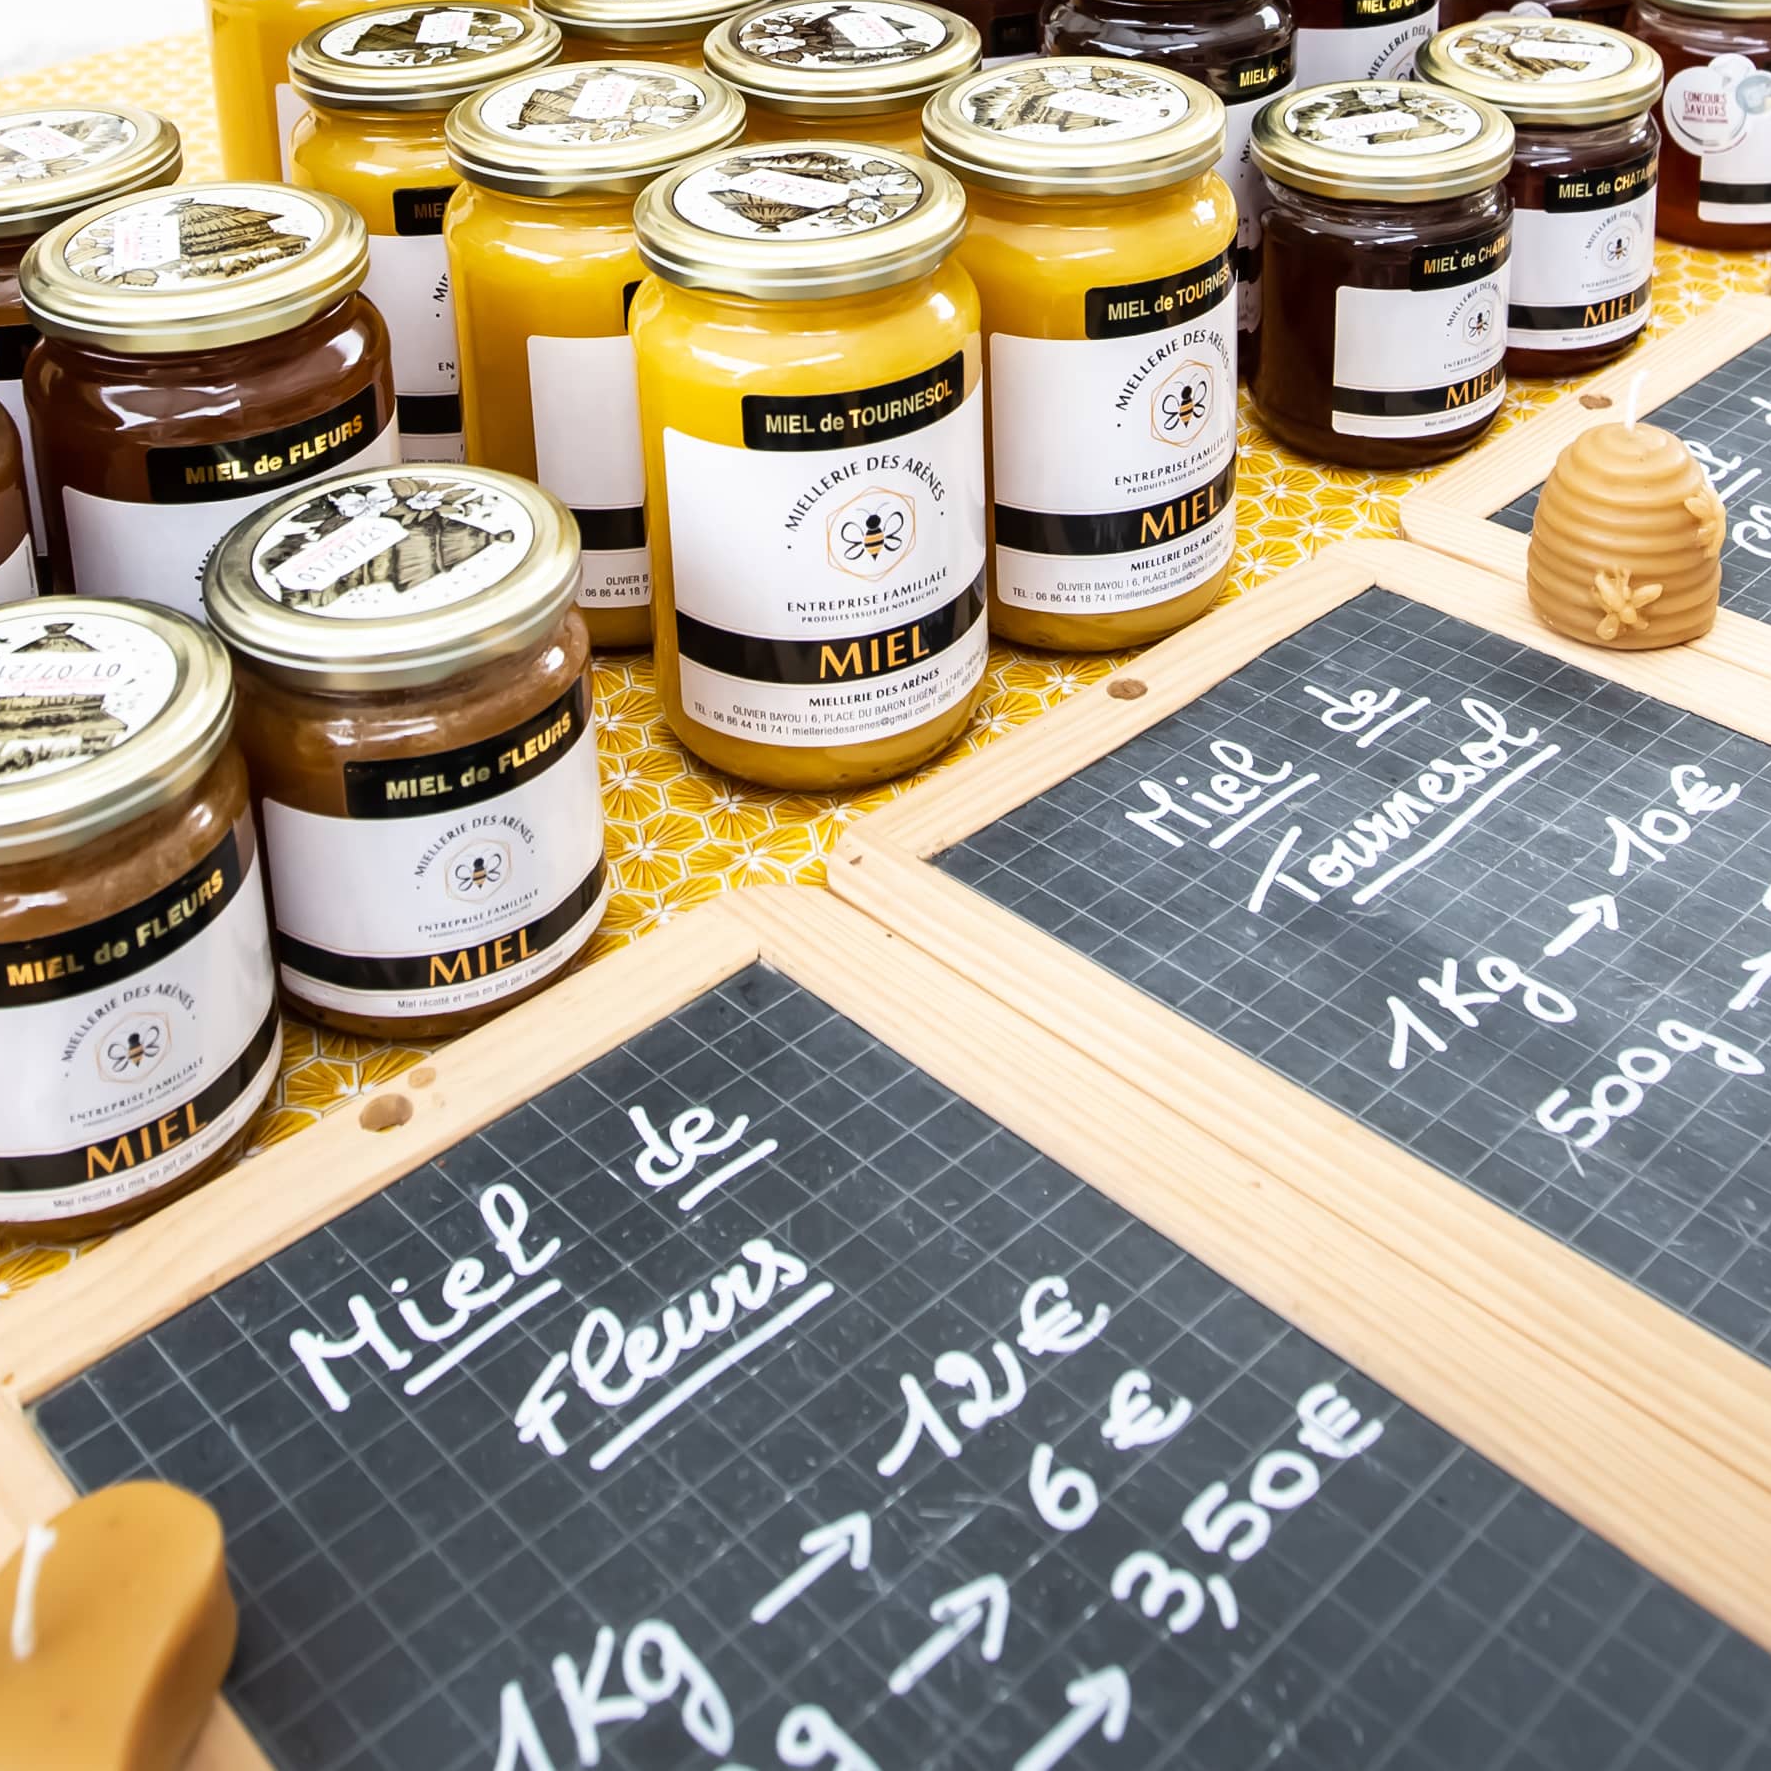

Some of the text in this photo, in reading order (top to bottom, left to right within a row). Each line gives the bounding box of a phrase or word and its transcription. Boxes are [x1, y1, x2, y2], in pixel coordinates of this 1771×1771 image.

[1559, 180, 1611, 199] MIEL de
[1424, 252, 1475, 275] MIEL de
[1108, 294, 1173, 320] MIEL de
[1584, 293, 1637, 328] MIEL
[1115, 329, 1205, 411] MIELLERIE DES
[765, 379, 953, 435] MIEL de TOURNESOL
[185, 414, 364, 485] MIEL de FLEURS
[1114, 458, 1188, 486] ENTREPRISE
[785, 454, 945, 532] MIELLERIE DES ARÈNES
[1139, 485, 1221, 545] MIEL
[787, 566, 948, 613] ENTREPRISE FAMILIALE
[1130, 549, 1181, 572] MIELLERIE
[819, 625, 930, 679] MIEL
[732, 704, 873, 724] OLIVIER BAYOU PLACE DU
[808, 666, 941, 708] MIELLERIE DES ARÈNES
[386, 711, 572, 802] MIEL de FLEURS
[1125, 685, 1400, 848] Miel de
[1249, 696, 1540, 914] Tournesol
[1610, 763, 1744, 879] 10€
[414, 814, 497, 877] MIELLERIE DES
[6, 868, 224, 987] MIEL de FLEURS
[418, 912, 484, 933] ENTREPRISE
[430, 928, 540, 988] MIEL
[61, 984, 150, 1064] MIELLERIE DES
[1537, 1017, 1767, 1149] 500g
[86, 1101, 209, 1180] MIEL
[290, 1106, 750, 1412] Miel de
[514, 1237, 809, 1456] Fleurs
[1111, 1382, 1384, 1632] 3,50€
